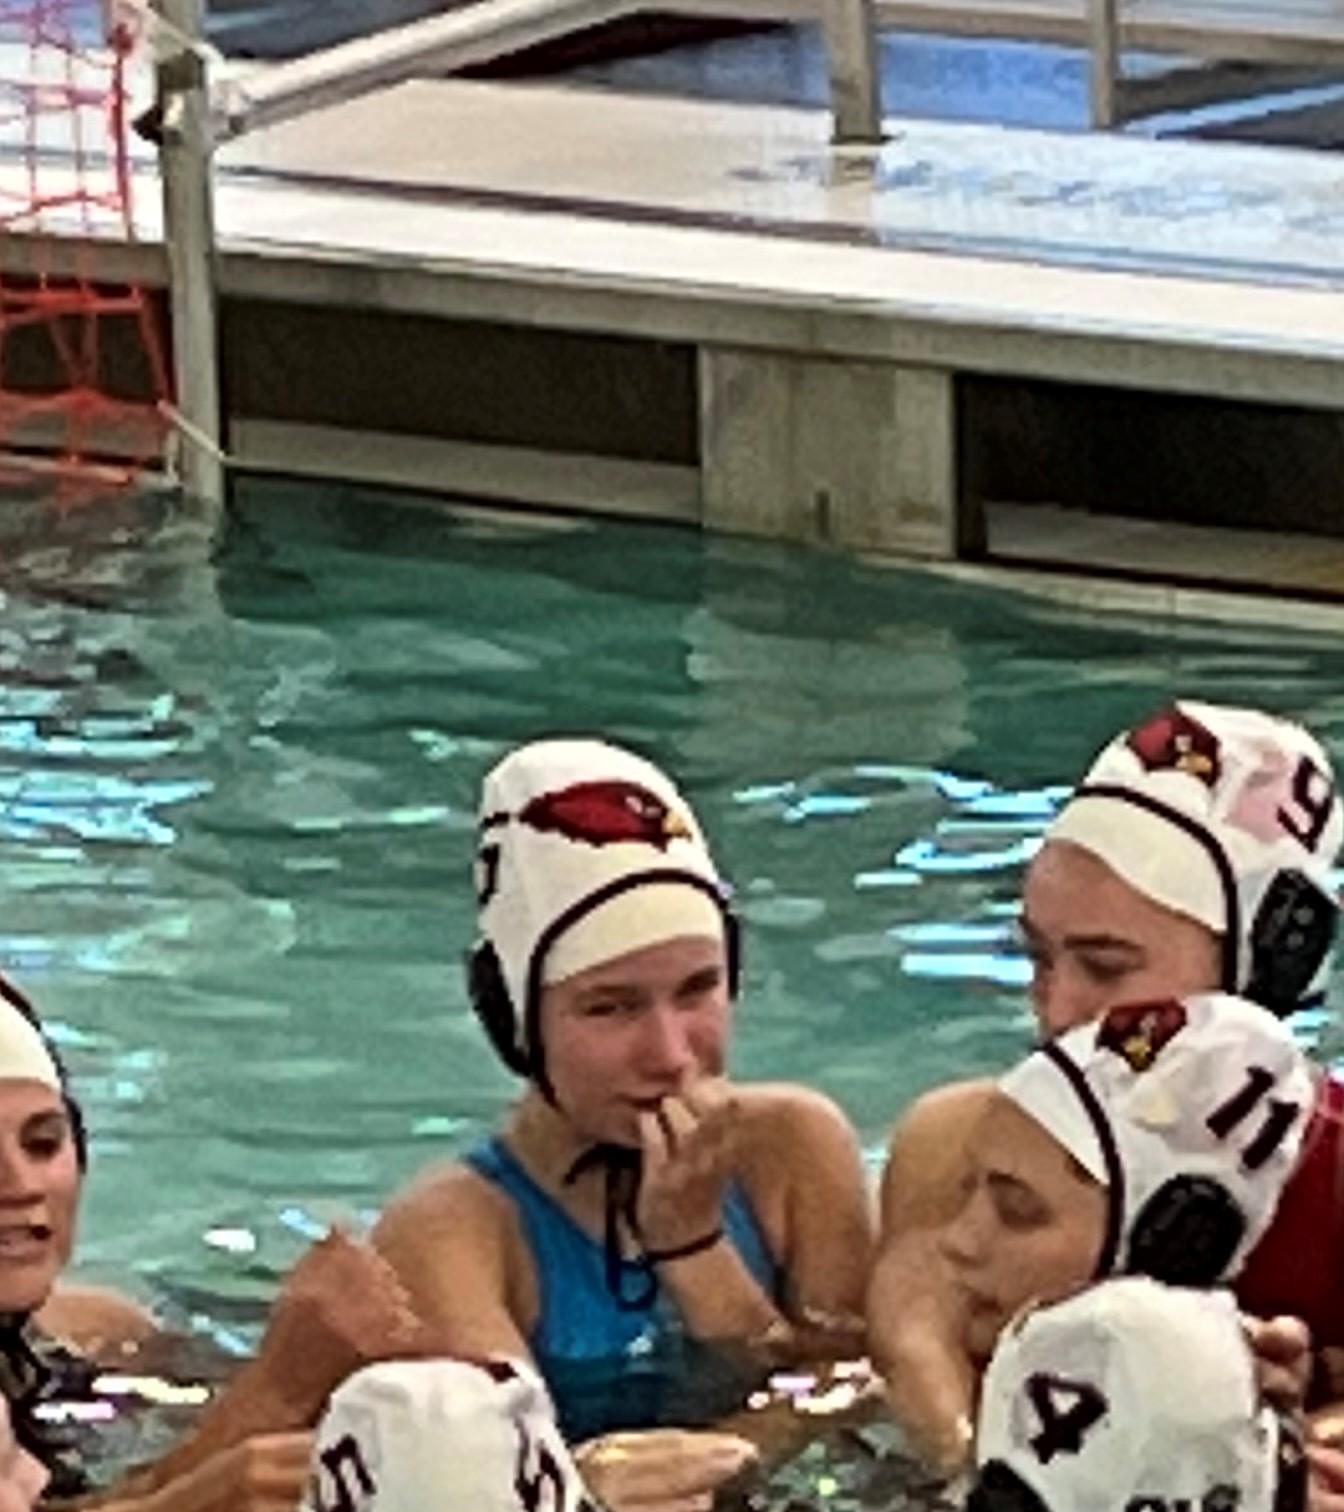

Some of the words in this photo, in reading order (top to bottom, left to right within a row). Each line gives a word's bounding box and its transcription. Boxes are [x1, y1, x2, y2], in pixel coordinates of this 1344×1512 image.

[1276, 756, 1334, 854] 9
[1206, 1066, 1299, 1169] 11
[1025, 1373, 1109, 1464] 4
